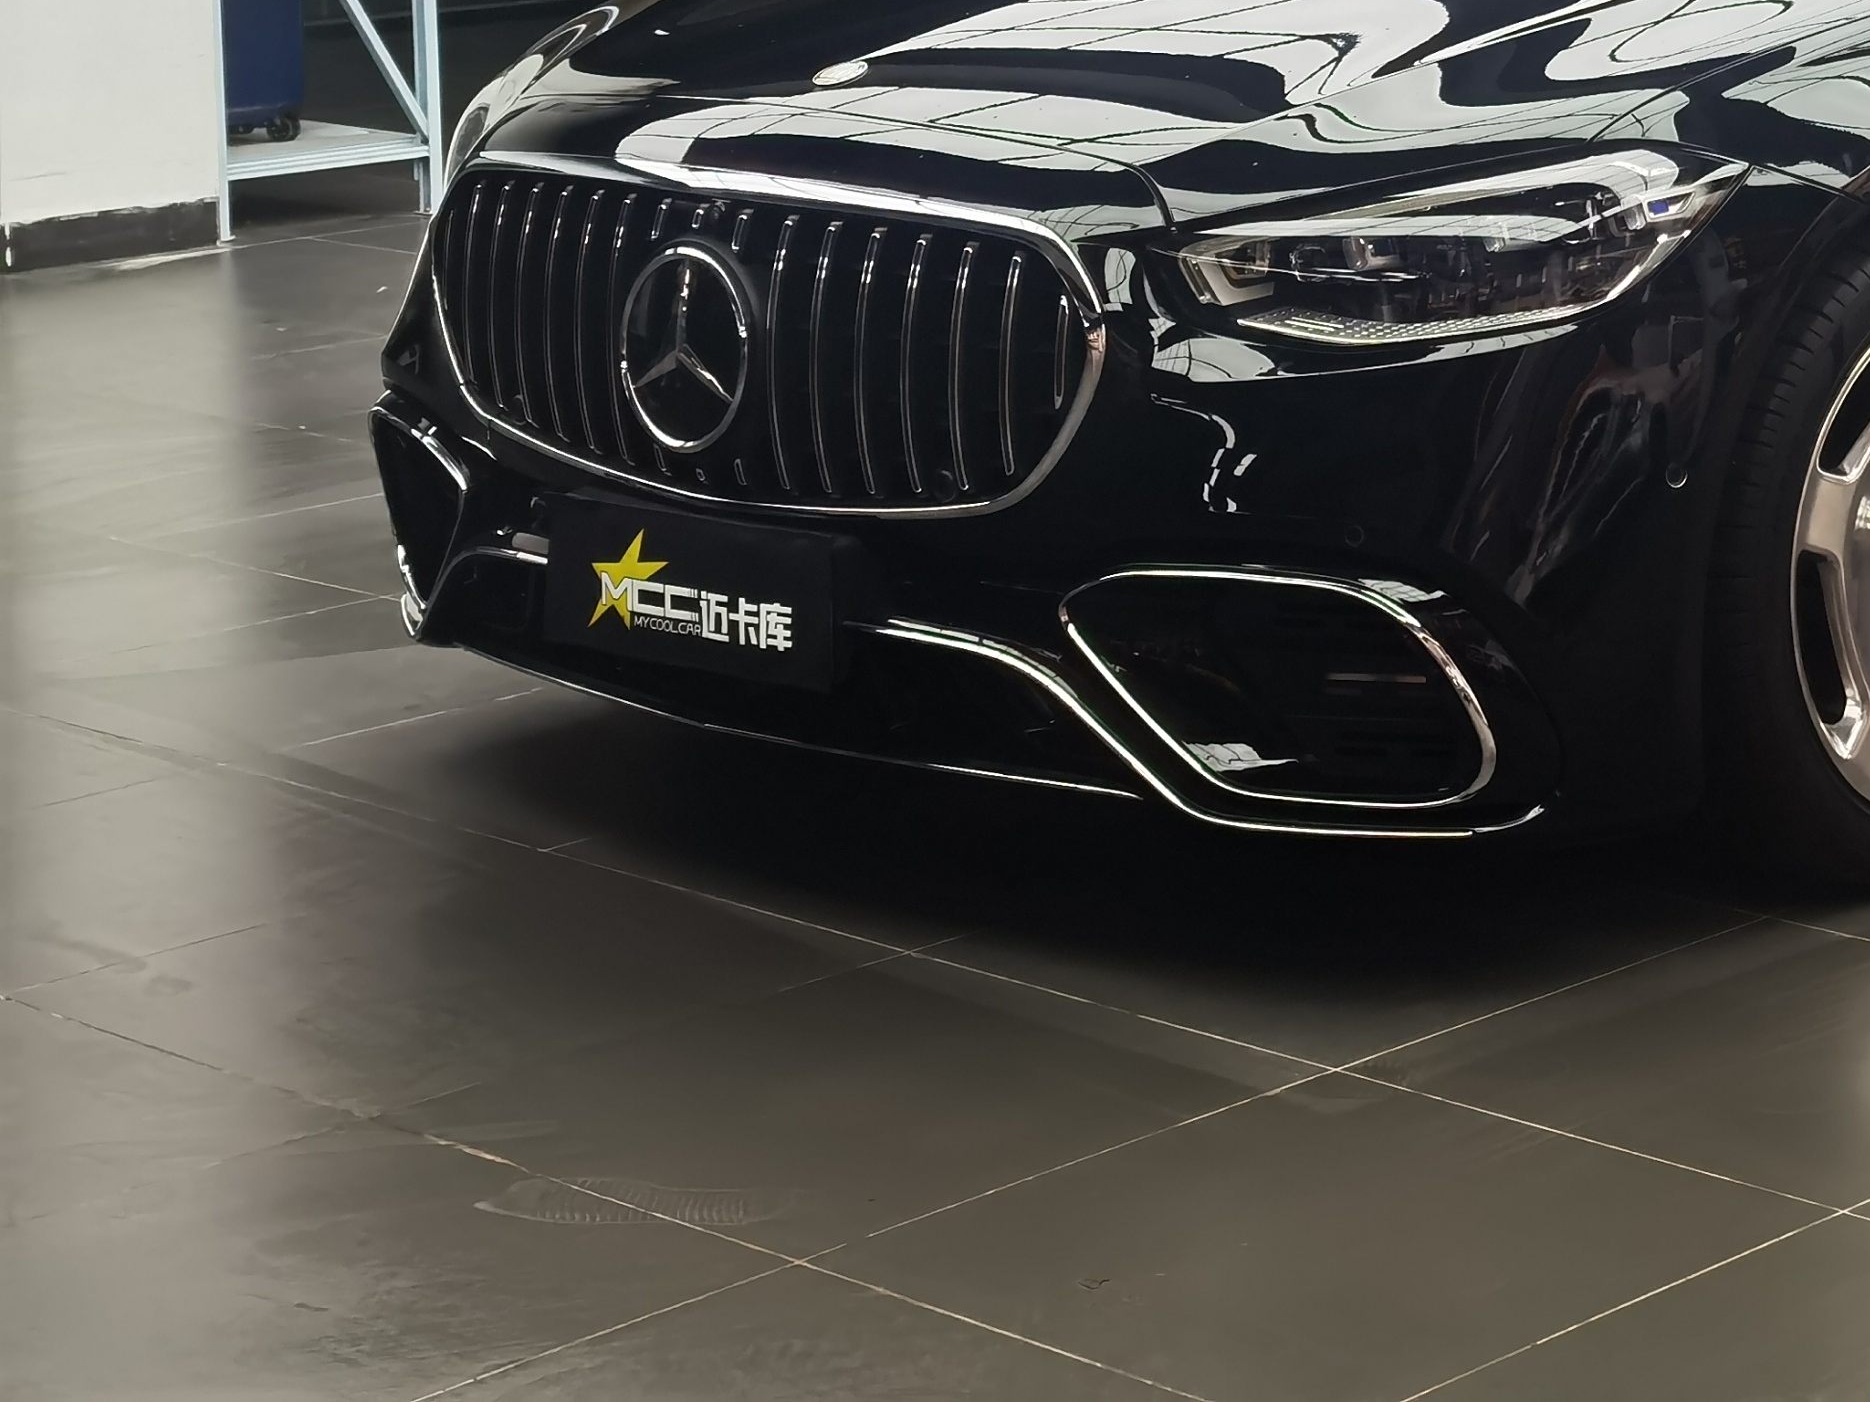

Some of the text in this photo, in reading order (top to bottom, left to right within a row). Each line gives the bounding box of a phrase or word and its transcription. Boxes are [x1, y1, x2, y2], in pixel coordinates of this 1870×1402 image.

[600, 571, 793, 652] MCC 迈卡库
[634, 614, 701, 637] MYCOOLCAR
